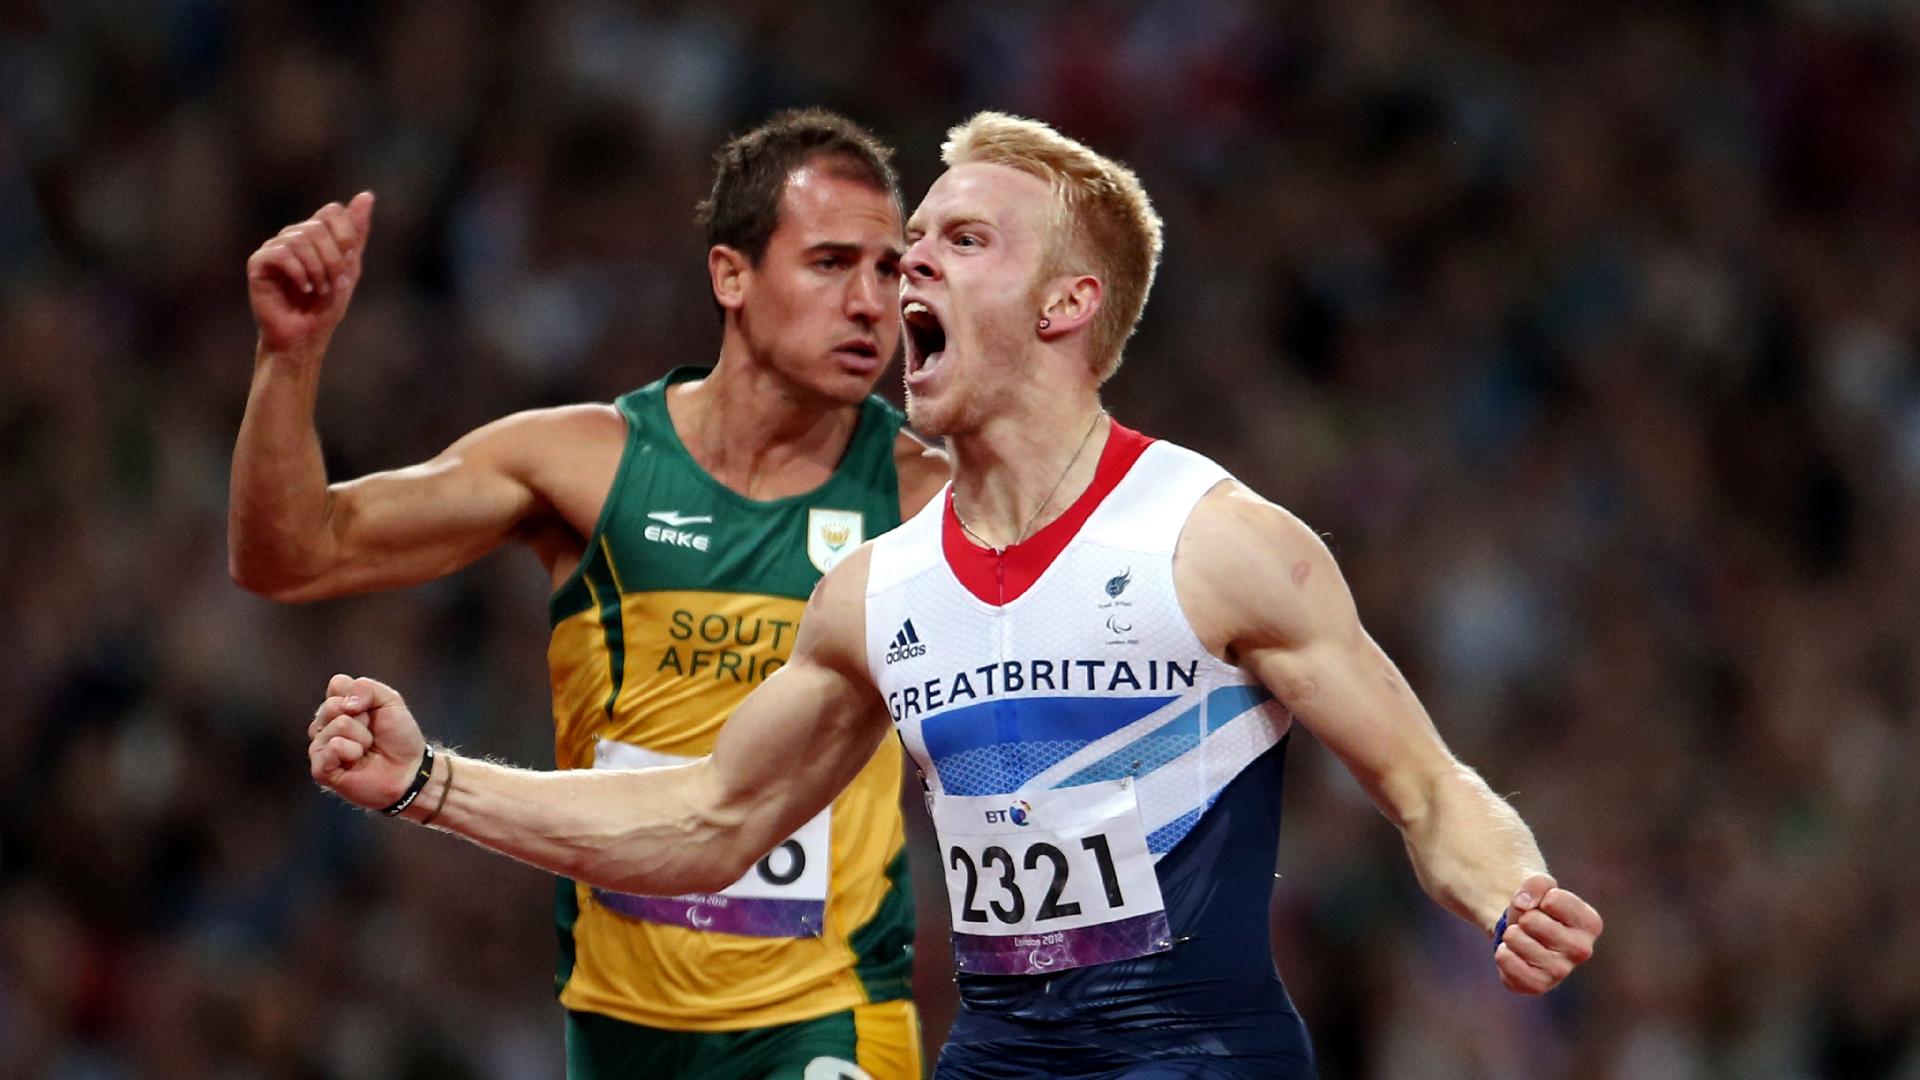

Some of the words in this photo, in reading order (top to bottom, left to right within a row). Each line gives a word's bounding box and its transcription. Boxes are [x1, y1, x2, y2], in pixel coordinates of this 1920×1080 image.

[644, 525, 711, 552] ERKE
[669, 608, 801, 651] SOUT
[657, 645, 788, 684] AFRIC
[885, 643, 927, 665] adidas
[985, 808, 1008, 824] BT
[951, 832, 1125, 925] 2321
[1041, 932, 1064, 946] 2012
